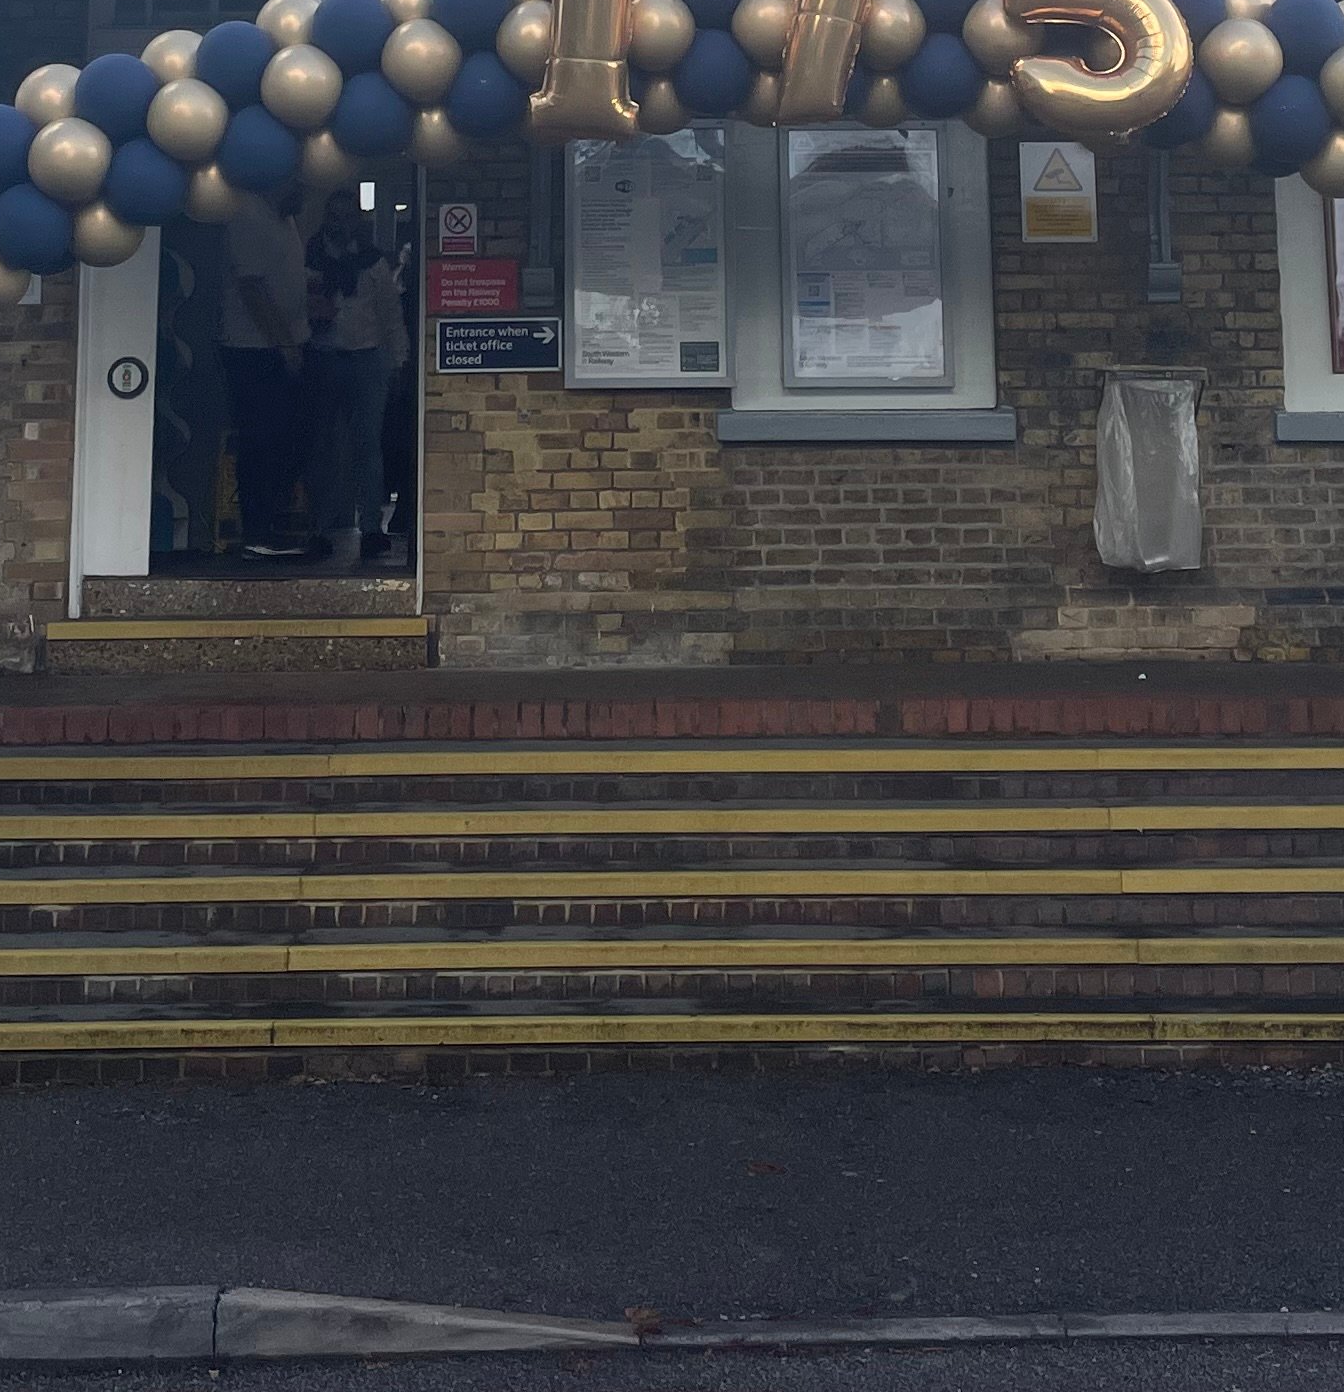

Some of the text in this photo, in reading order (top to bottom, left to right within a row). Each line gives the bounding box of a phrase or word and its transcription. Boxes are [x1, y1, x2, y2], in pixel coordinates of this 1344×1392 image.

[445, 326, 529, 337] Entrance when
[445, 339, 513, 351] ticket office
[445, 354, 482, 365] closed
